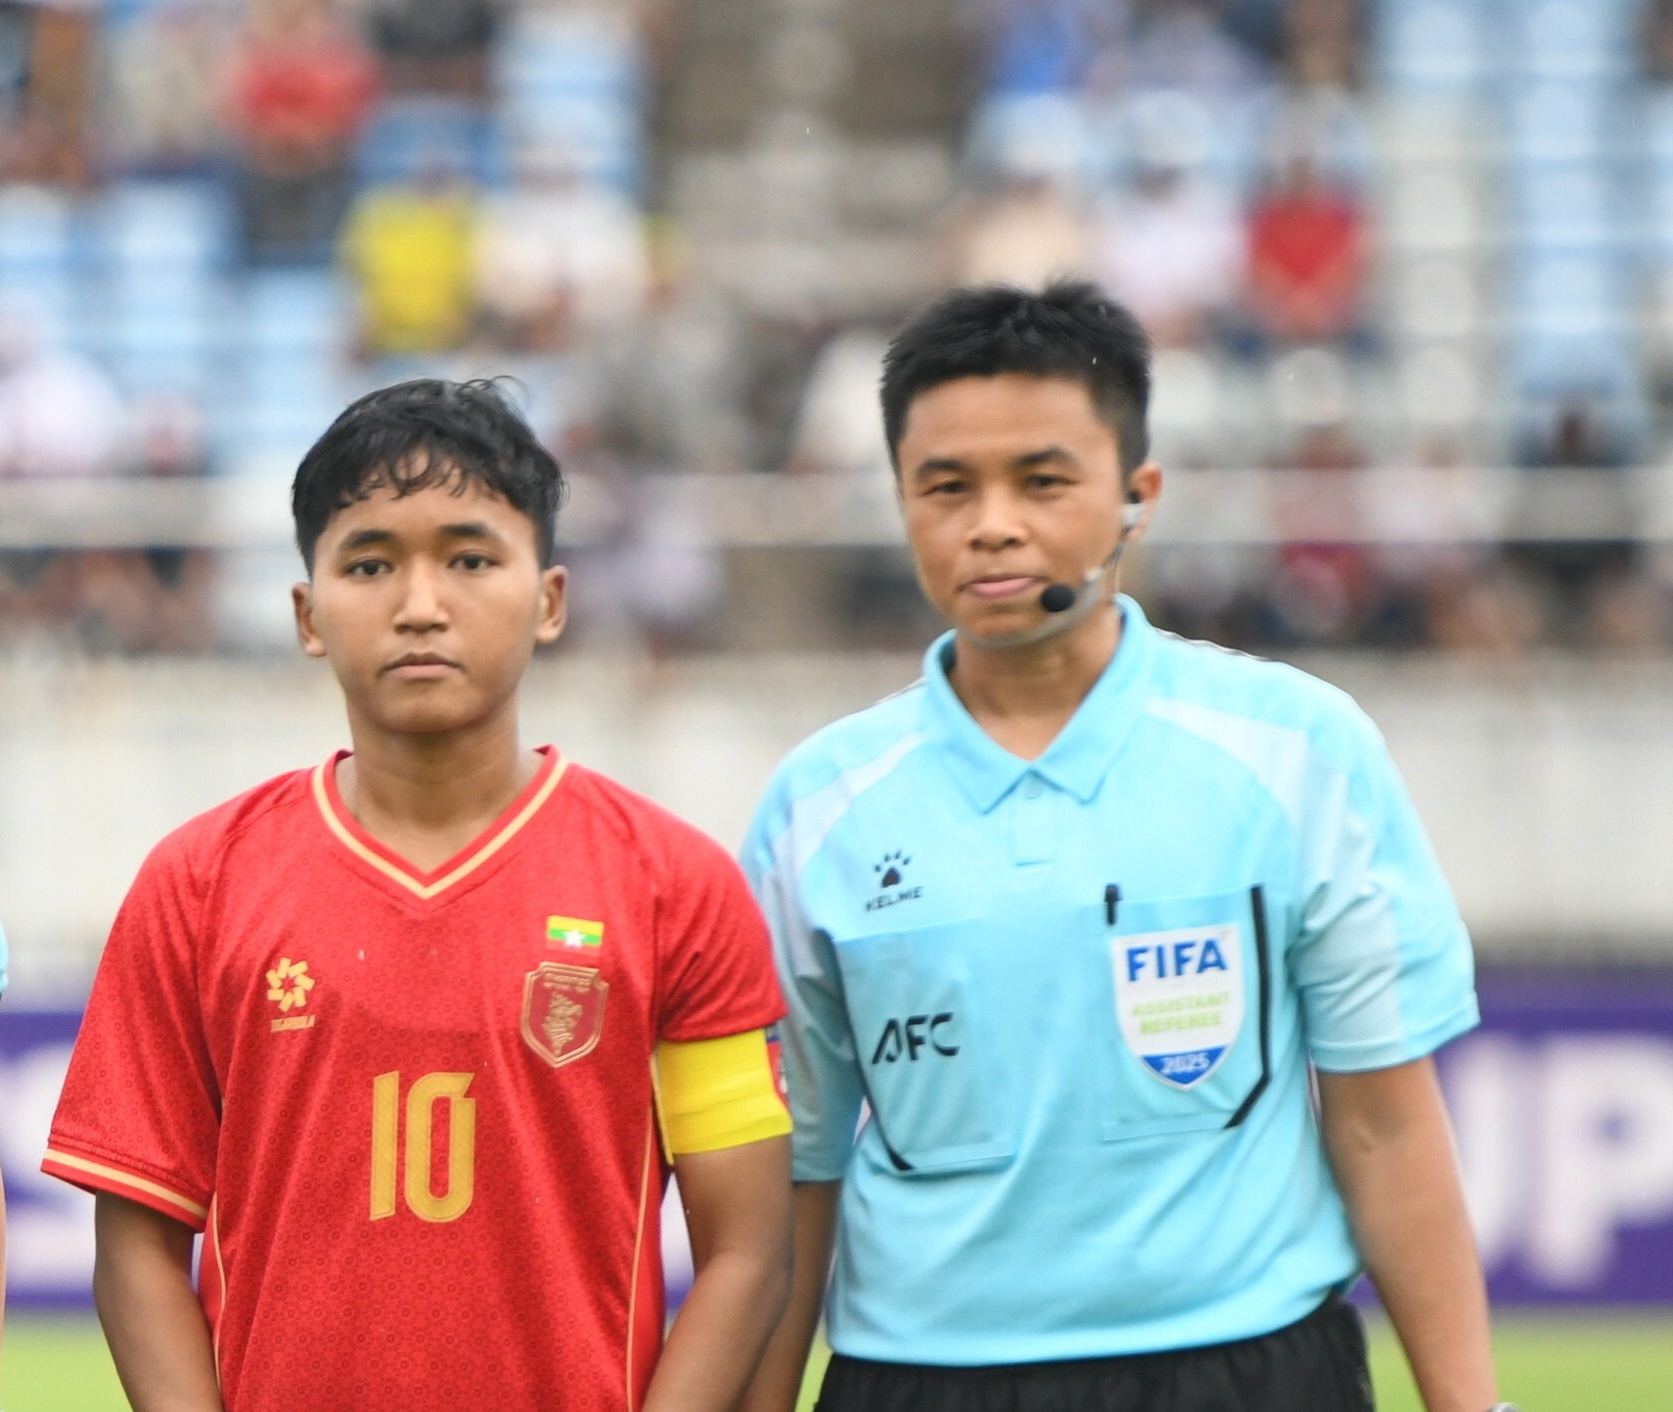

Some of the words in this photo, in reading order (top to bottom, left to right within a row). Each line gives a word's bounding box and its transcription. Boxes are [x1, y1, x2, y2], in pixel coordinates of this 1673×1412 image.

[865, 886, 924, 912] KELME
[1126, 937, 1228, 982] FIFA
[871, 1012, 961, 1065] AFC
[370, 1070, 477, 1224] 10
